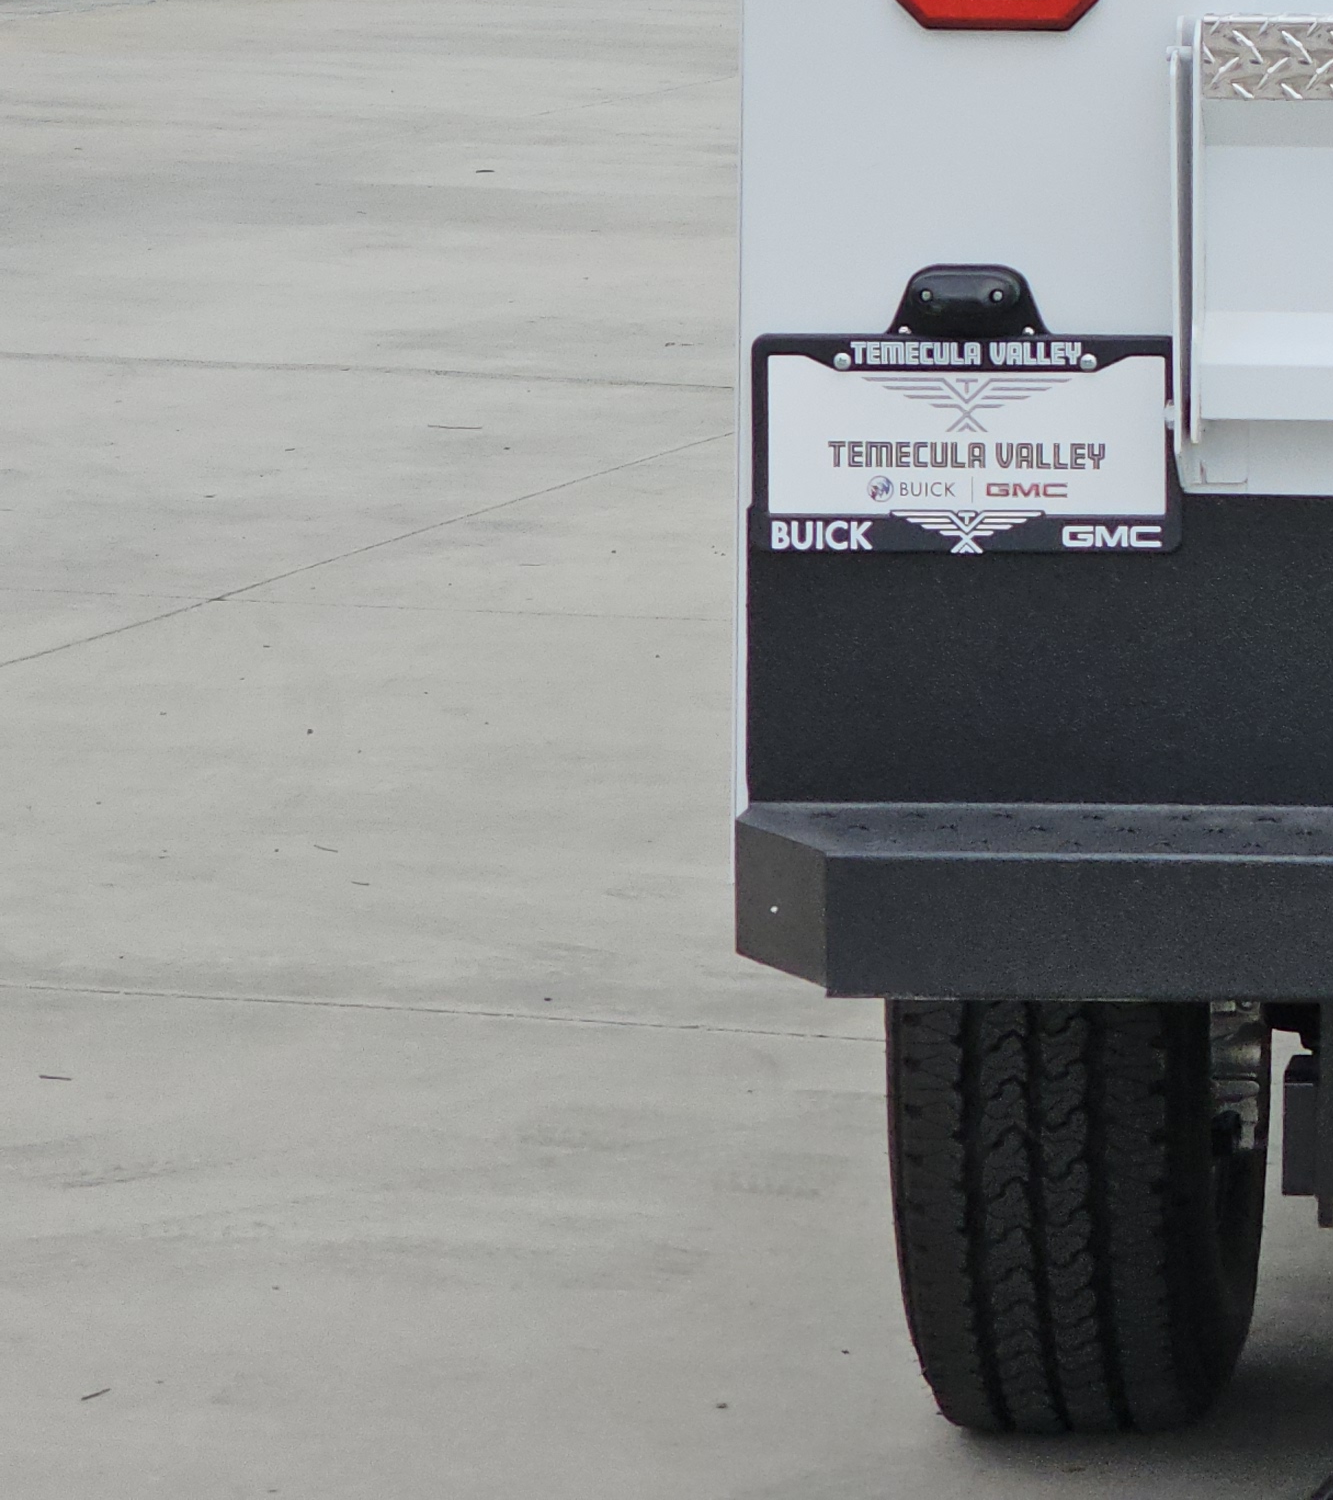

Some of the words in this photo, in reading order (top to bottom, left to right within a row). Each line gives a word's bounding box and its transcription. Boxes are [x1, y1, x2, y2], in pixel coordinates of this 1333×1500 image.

[850, 341, 981, 366] TEMECULA
[989, 341, 1082, 367] VALLEY
[828, 440, 986, 468] TEMECULA
[995, 442, 1106, 470] VALLEY
[899, 481, 956, 498] BUICK
[985, 482, 1068, 499] GMC
[771, 520, 873, 550] BUICK
[1061, 524, 1162, 548] GMC
